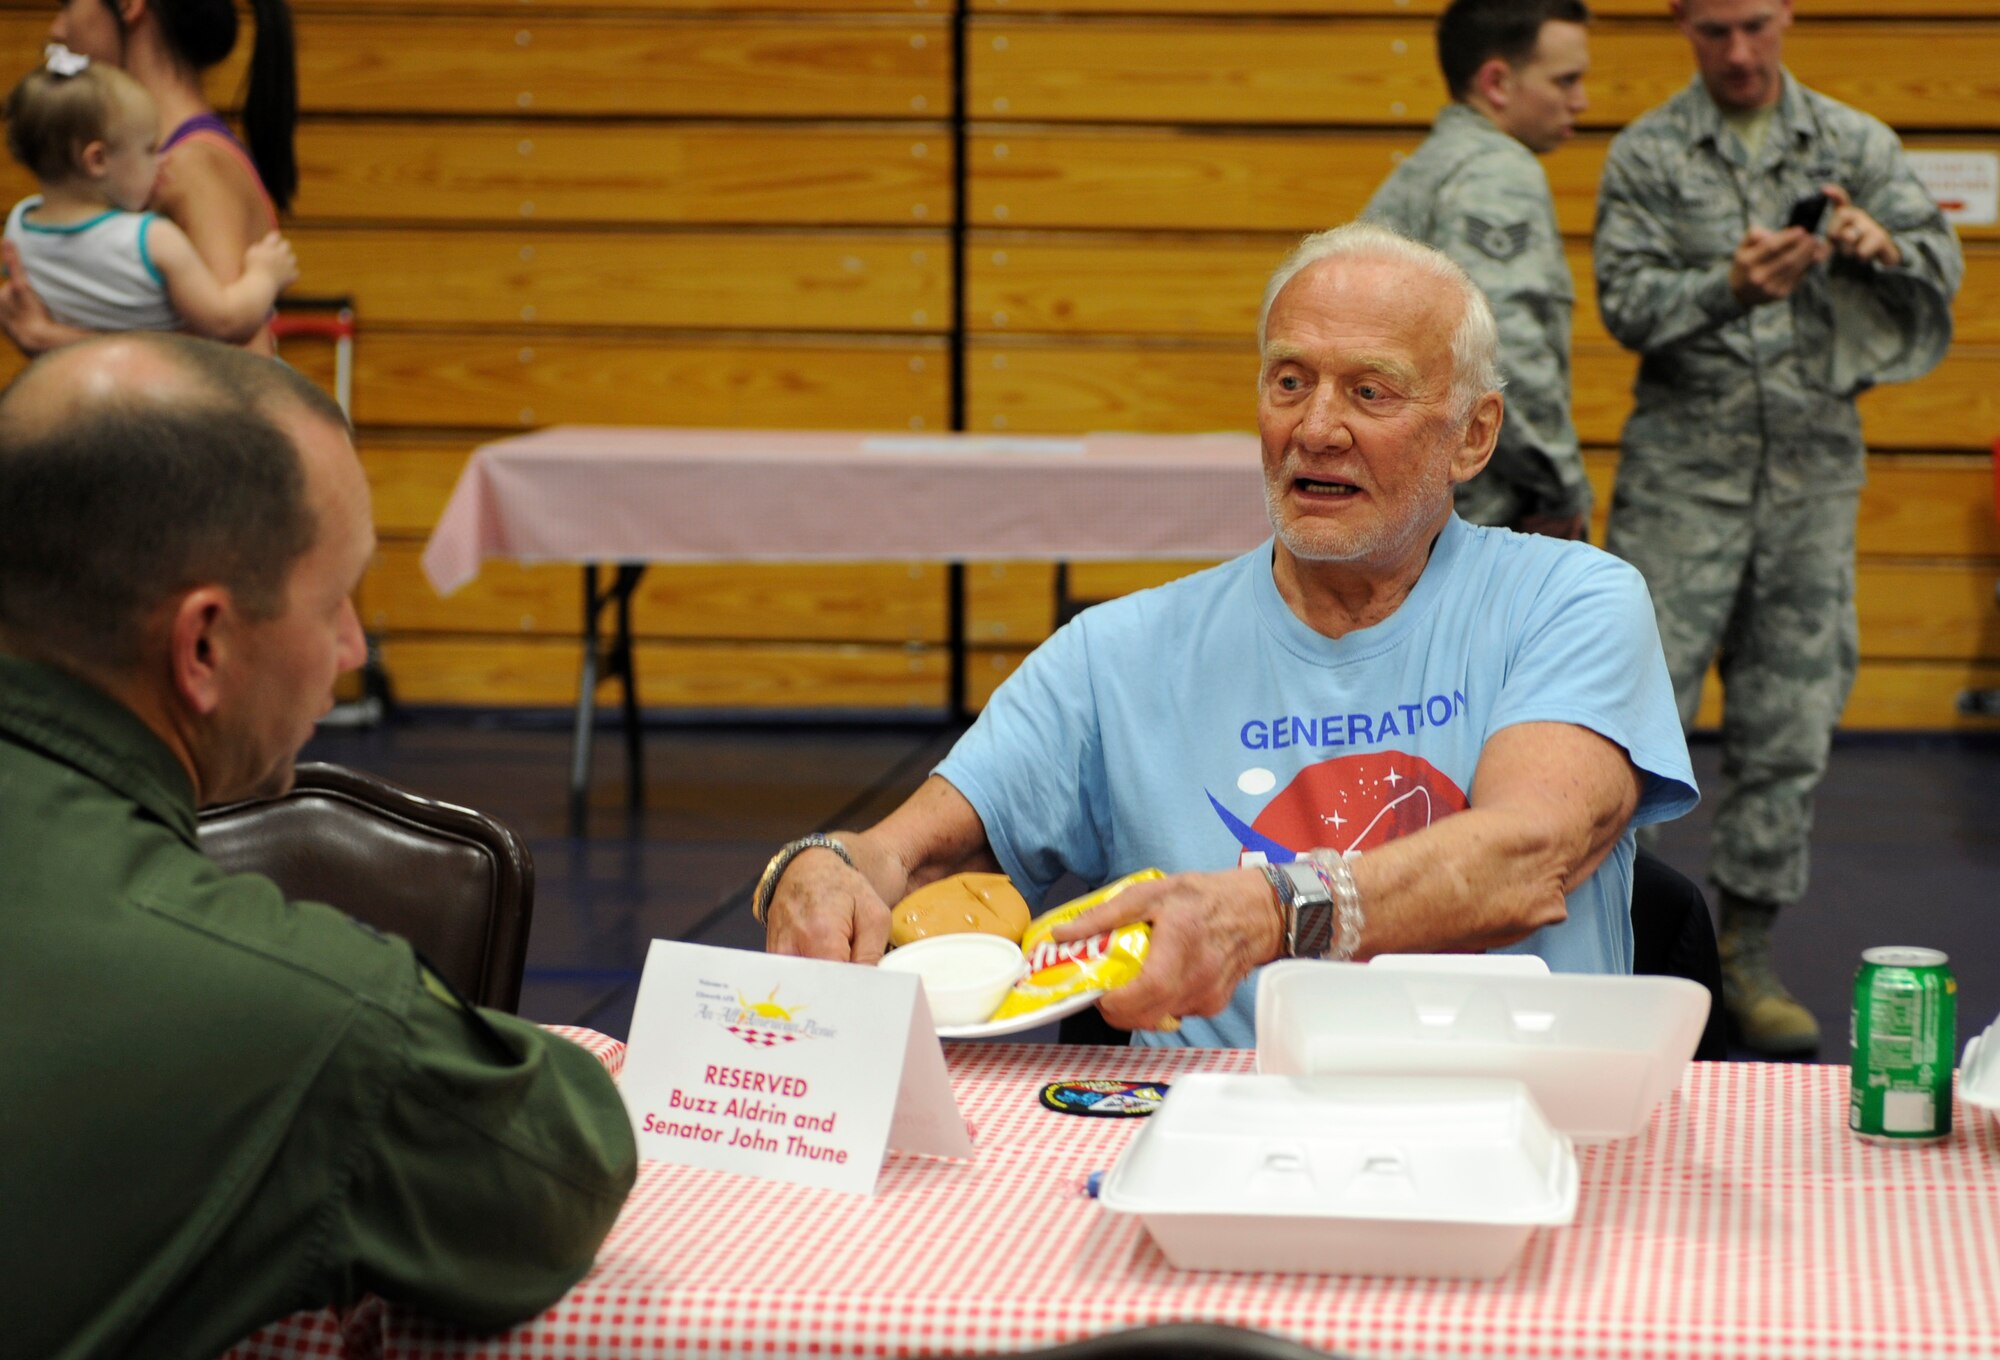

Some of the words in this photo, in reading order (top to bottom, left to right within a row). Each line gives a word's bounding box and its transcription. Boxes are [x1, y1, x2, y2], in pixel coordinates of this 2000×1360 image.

[1240, 689, 1467, 750] GENERATION
[704, 1064, 808, 1098] RESERVED
[669, 1088, 718, 1114] Buzz
[723, 1097, 787, 1126] Aldrin
[794, 1111, 837, 1133] and
[642, 1112, 724, 1143] Senator
[728, 1126, 779, 1153] John
[786, 1135, 848, 1165] Thune
